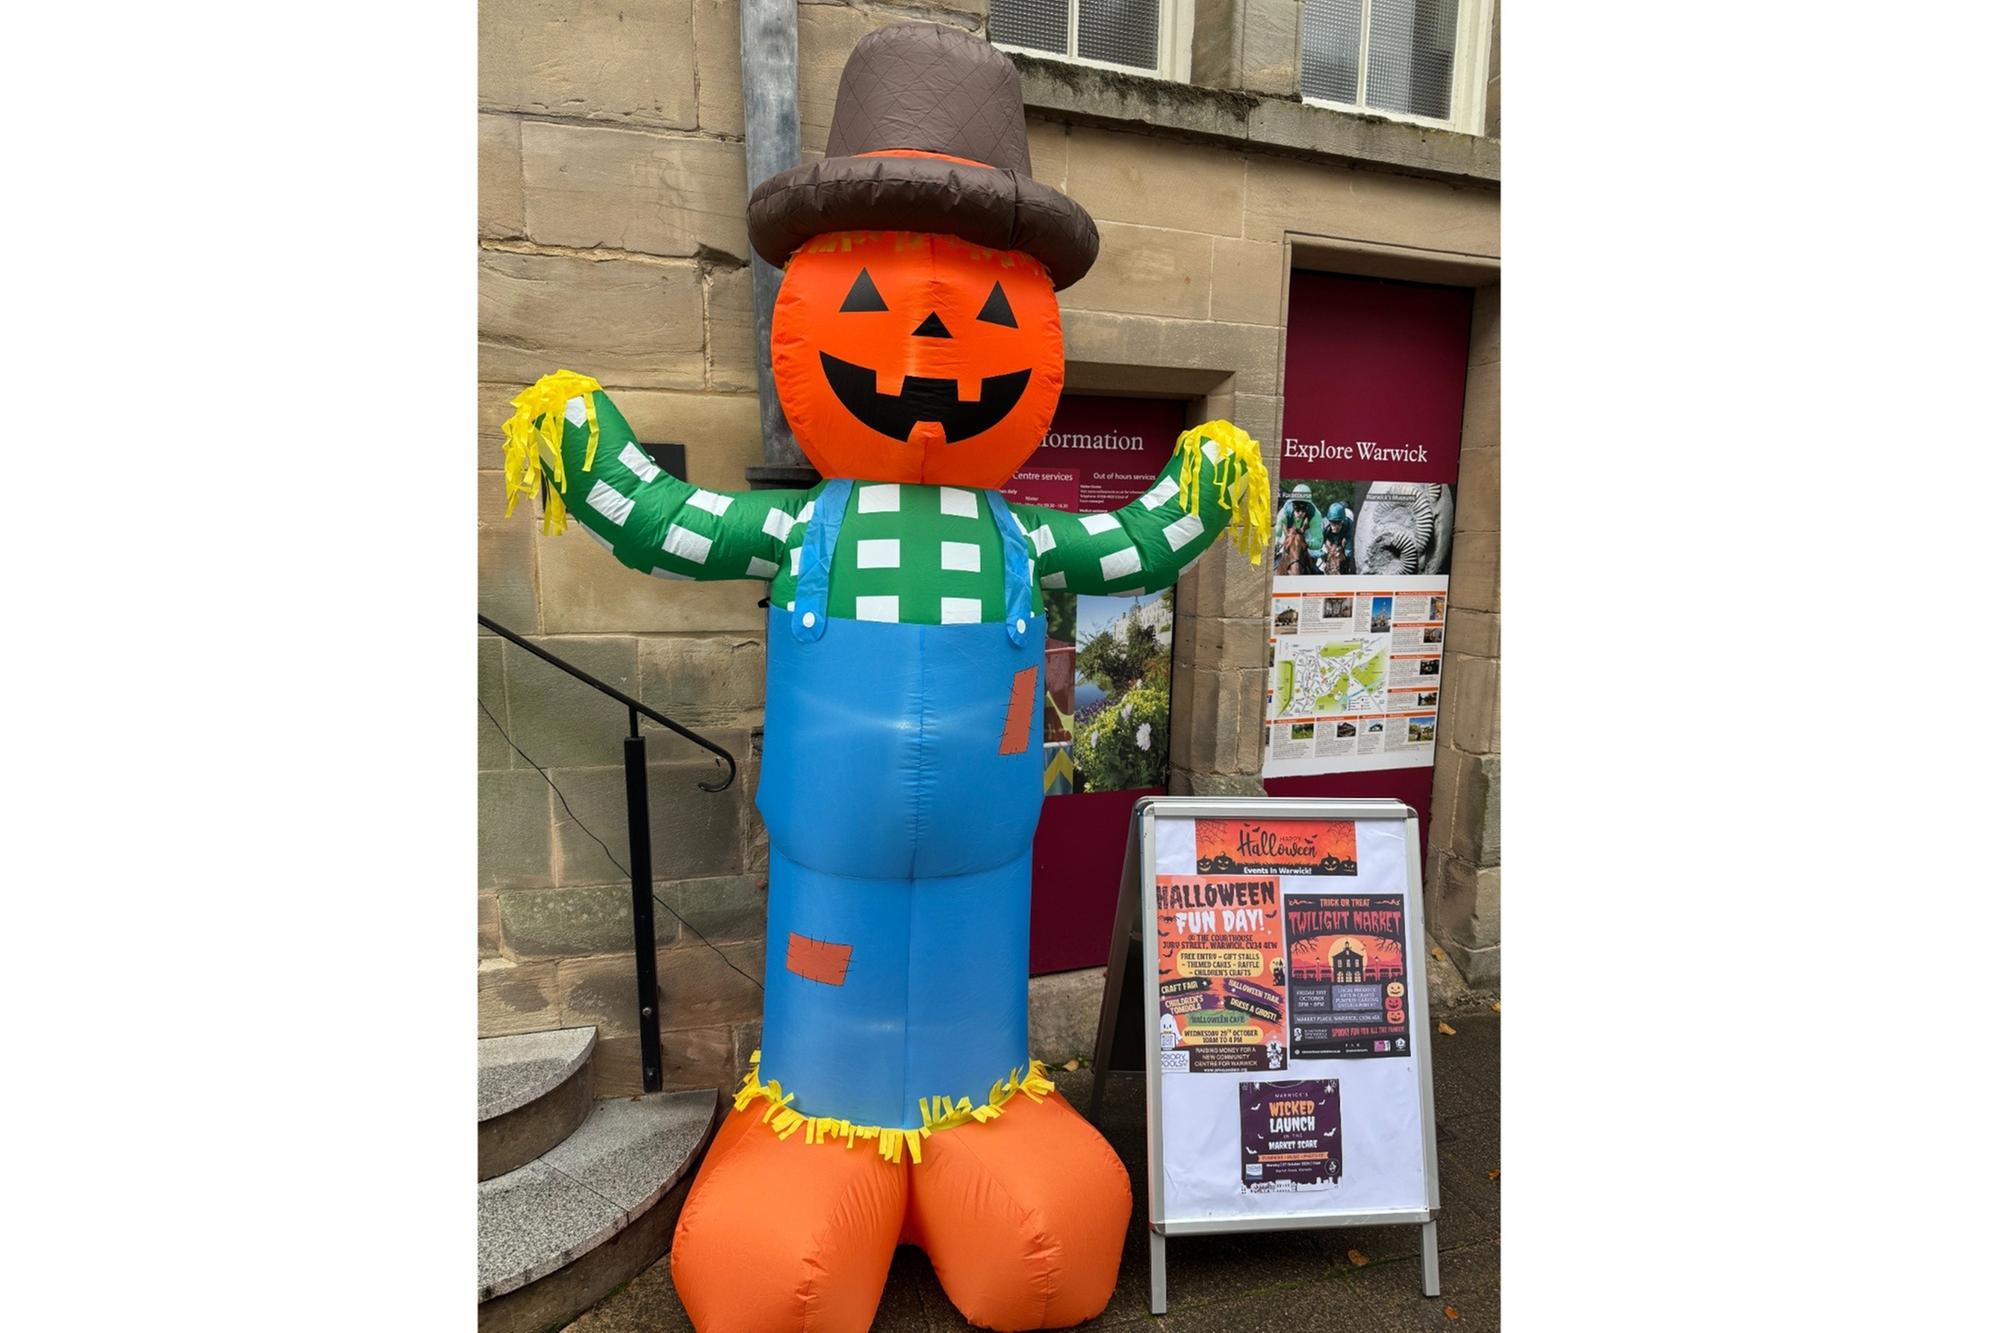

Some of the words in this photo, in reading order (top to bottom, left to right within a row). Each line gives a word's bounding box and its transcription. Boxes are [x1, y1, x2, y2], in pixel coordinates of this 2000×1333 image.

[1038, 427, 1144, 450] formation
[1284, 438, 1353, 462] Explore
[1356, 441, 1428, 463] Warwick
[1012, 471, 1040, 480] Centre
[1041, 472, 1073, 481] services
[1093, 472, 1106, 480] Out
[1106, 472, 1114, 480] of
[1115, 472, 1132, 480] hours
[1133, 473, 1156, 481] services
[1237, 830, 1318, 857] Halloween
[1278, 867, 1312, 875] Warwick!
[1156, 881, 1275, 910] HALLOWEEN
[1320, 899, 1339, 907] TRICK
[1340, 899, 1350, 907] OR
[1351, 898, 1370, 907] TREAT
[1175, 910, 1216, 935] FUN
[1222, 908, 1265, 934] DAY!
[1288, 911, 1349, 935] TWILIGHT
[1353, 911, 1401, 935] MARKET
[1161, 984, 1182, 994] CRAFT
[1183, 981, 1198, 991] FAIR
[1228, 979, 1264, 998] HALLOWEEN
[1263, 990, 1280, 1004] TRAIL
[1164, 995, 1204, 1008] CHILDREN'S
[1170, 1003, 1202, 1015] TOMBOLA
[1230, 998, 1250, 1011] DRESS
[1249, 1005, 1255, 1013] A
[1255, 1007, 1277, 1021] GHOST!
[1192, 1015, 1229, 1024] HALLOWEEN
[1185, 1029, 1219, 1037] WEDNESDAY
[1269, 1100, 1315, 1116] WICKED
[1269, 1116, 1315, 1133] LAUNCH
[1269, 1140, 1296, 1150] MARKET
[1297, 1139, 1318, 1149] SCARE
